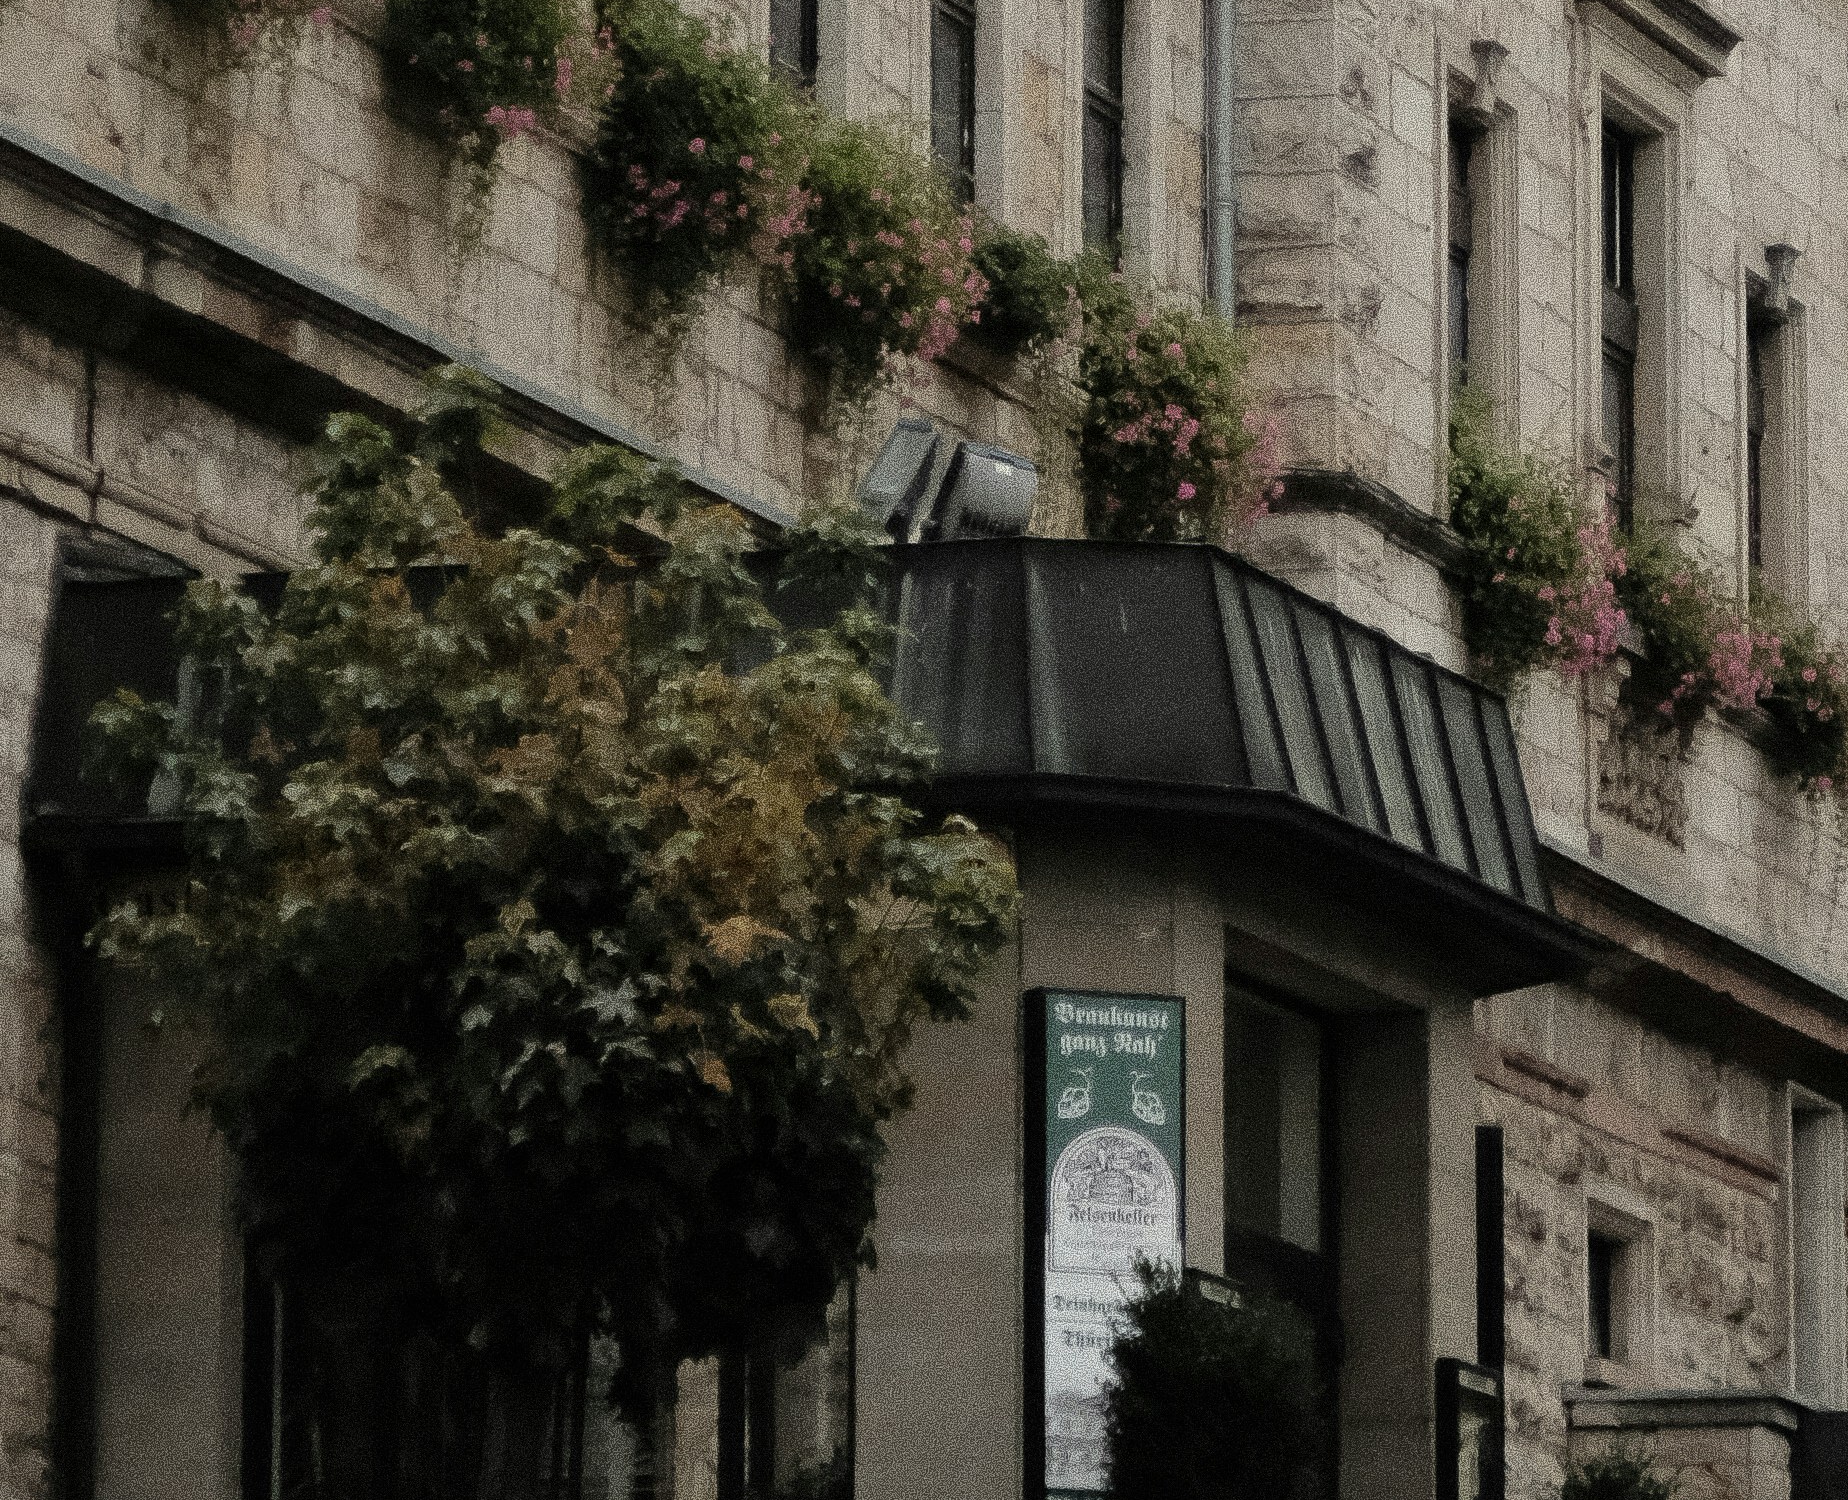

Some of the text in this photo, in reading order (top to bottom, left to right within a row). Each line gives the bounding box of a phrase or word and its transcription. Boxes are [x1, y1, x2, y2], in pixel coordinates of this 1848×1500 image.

[1054, 1001, 1169, 1031] Braukunst
[1060, 1033, 1107, 1058] ganz
[1067, 1203, 1158, 1226] Felsenkeller
